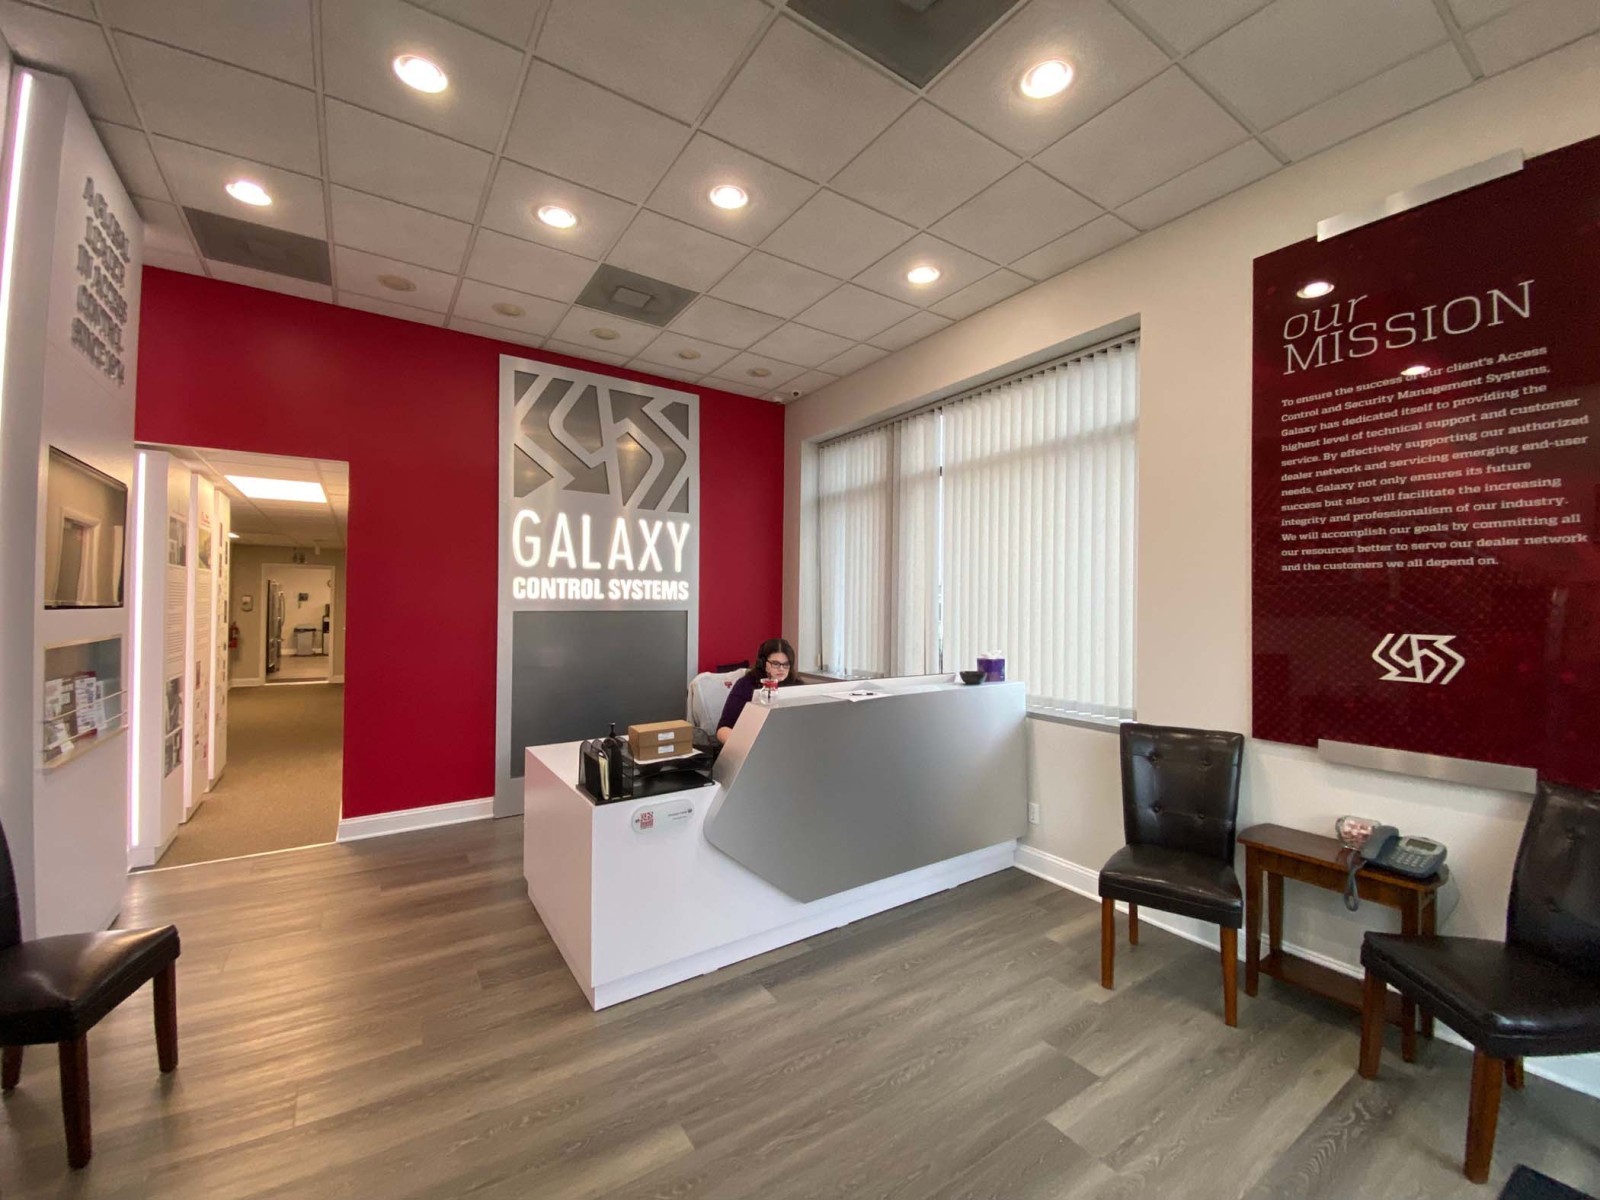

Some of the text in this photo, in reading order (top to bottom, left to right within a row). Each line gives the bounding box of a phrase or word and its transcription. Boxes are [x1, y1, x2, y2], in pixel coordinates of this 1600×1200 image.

[1283, 294, 1368, 341] our
[1283, 279, 1535, 375] MISSION
[1281, 398, 1294, 407] To
[1296, 390, 1332, 404] ensure
[1335, 386, 1354, 396] the
[1356, 375, 1403, 391] success
[1421, 367, 1444, 378] our
[1446, 356, 1494, 373] client's
[1496, 346, 1547, 363] Access
[1281, 407, 1319, 422] Control
[1321, 402, 1342, 414] and
[1344, 394, 1395, 410] Security
[1398, 376, 1482, 399] Management
[1281, 384, 1547, 437] Galaxy has dedicated itself to providing the
[1281, 398, 1580, 452] highest level of technical support and customer
[1281, 414, 1589, 466] service. By effectively supporting our authorized
[1281, 436, 1588, 481] dealer network and servicing emerging end-user
[1281, 477, 1561, 511] success but also will facilitate the increasing
[1316, 481, 1355, 492] Galaxy
[1358, 478, 1376, 488] not
[1380, 475, 1407, 485] only
[1410, 469, 1462, 482] ensures
[1466, 466, 1483, 476] its
[1486, 461, 1531, 473] future
[1281, 496, 1568, 526] integrity and professionalism of our industry.
[1281, 513, 1580, 541] We will accomplish our goals by committing all
[512, 509, 690, 573] GALAXY
[1281, 532, 1588, 556] our resources better to serve our dealer network
[1281, 556, 1498, 571] and the customers we all depend on.
[513, 576, 689, 600] CONTROL SYSTEMS
